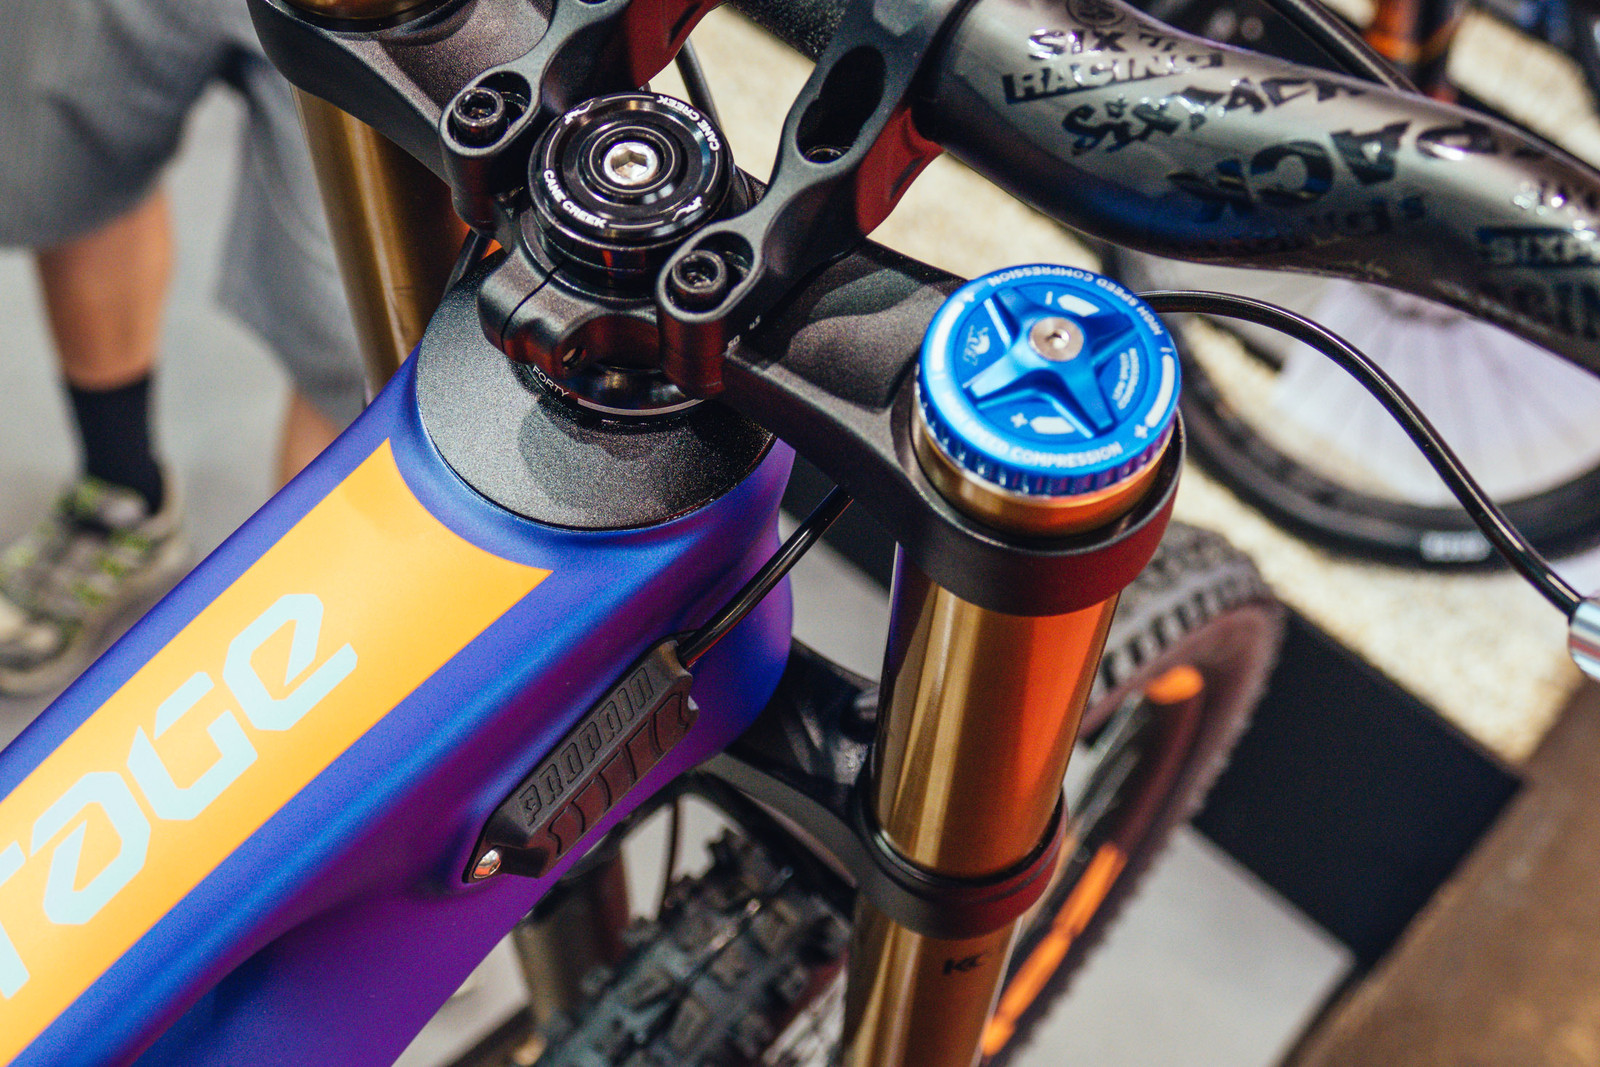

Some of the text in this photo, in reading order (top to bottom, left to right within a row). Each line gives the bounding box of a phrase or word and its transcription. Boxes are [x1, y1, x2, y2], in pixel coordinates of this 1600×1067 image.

[1002, 52, 1224, 105] RACING
[656, 94, 720, 151] CANE CREEK
[543, 169, 608, 229] CANE CREEK
[986, 266, 1164, 336] HIGH SPEED COMPRESSION
[531, 363, 569, 397] FORTY
[1009, 441, 1123, 469] COMPRESSION
